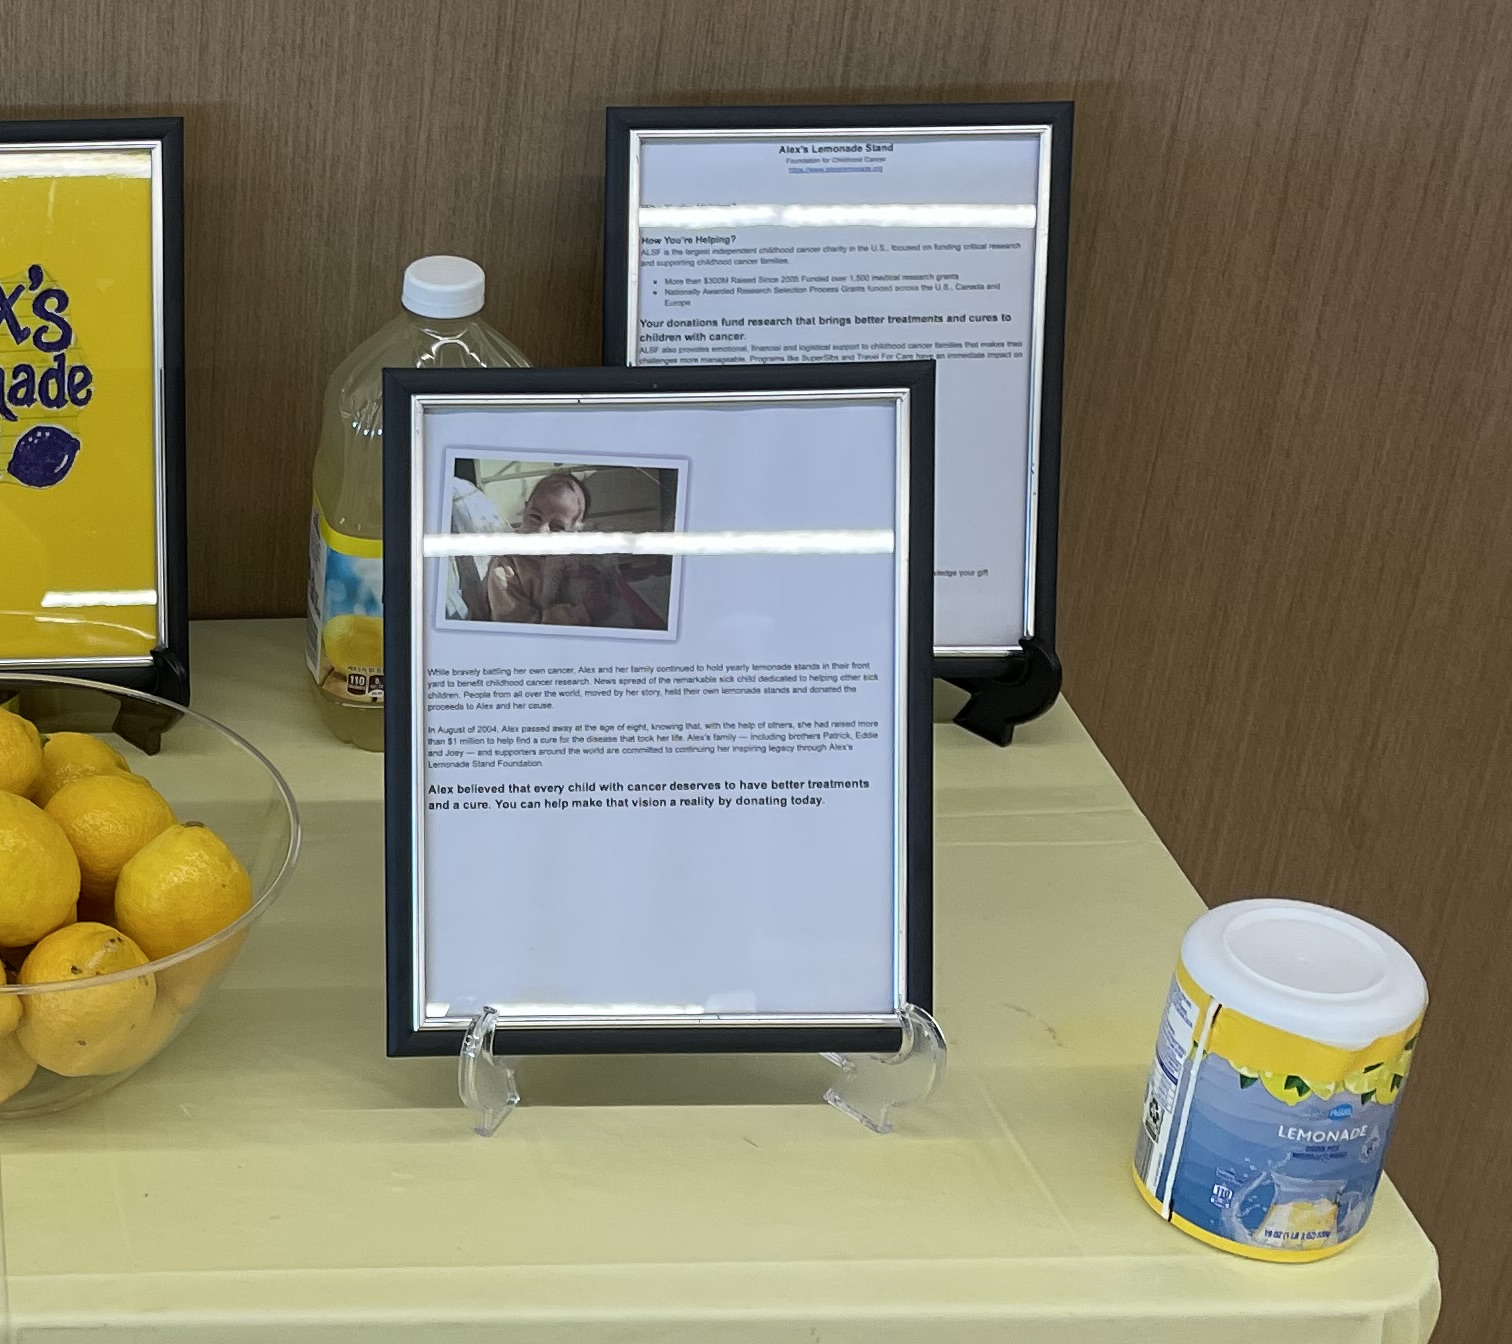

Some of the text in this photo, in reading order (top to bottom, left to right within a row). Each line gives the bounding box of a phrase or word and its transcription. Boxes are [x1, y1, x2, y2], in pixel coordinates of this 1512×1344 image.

[779, 144, 893, 153] Alex's Lemonade Stand
[695, 235, 736, 245] Helping?
[640, 319, 664, 327] Your
[666, 318, 718, 327] donations
[721, 317, 744, 326] fund
[747, 317, 792, 326] research
[796, 317, 815, 325] that
[818, 316, 851, 326] brings
[854, 315, 884, 324] better
[887, 315, 943, 323] treatments
[946, 314, 965, 322] and
[639, 333, 681, 342] children
[684, 332, 706, 341] with
[427, 668, 449, 676] While
[452, 668, 480, 677] bravely
[482, 667, 511, 676] battling
[630, 665, 654, 674] family
[656, 664, 694, 672] continued
[706, 663, 723, 671] hold
[725, 664, 749, 672] yearly
[851, 661, 870, 669] front
[350, 676, 365, 686] 110
[427, 703, 464, 711] proceeds
[428, 760, 469, 768] Lemonade
[428, 779, 869, 794] Alex believed that every child with cancer deserves to have better treatments
[428, 800, 449, 809] and
[495, 799, 516, 808] You
[544, 798, 568, 809] help
[572, 797, 602, 807] make
[606, 797, 628, 807] that
[632, 797, 666, 806] vision
[680, 796, 713, 808] reality
[718, 796, 731, 807] by
[735, 795, 786, 807] donating
[790, 795, 825, 806] today.
[1278, 1125, 1368, 1143] LEMONADE
